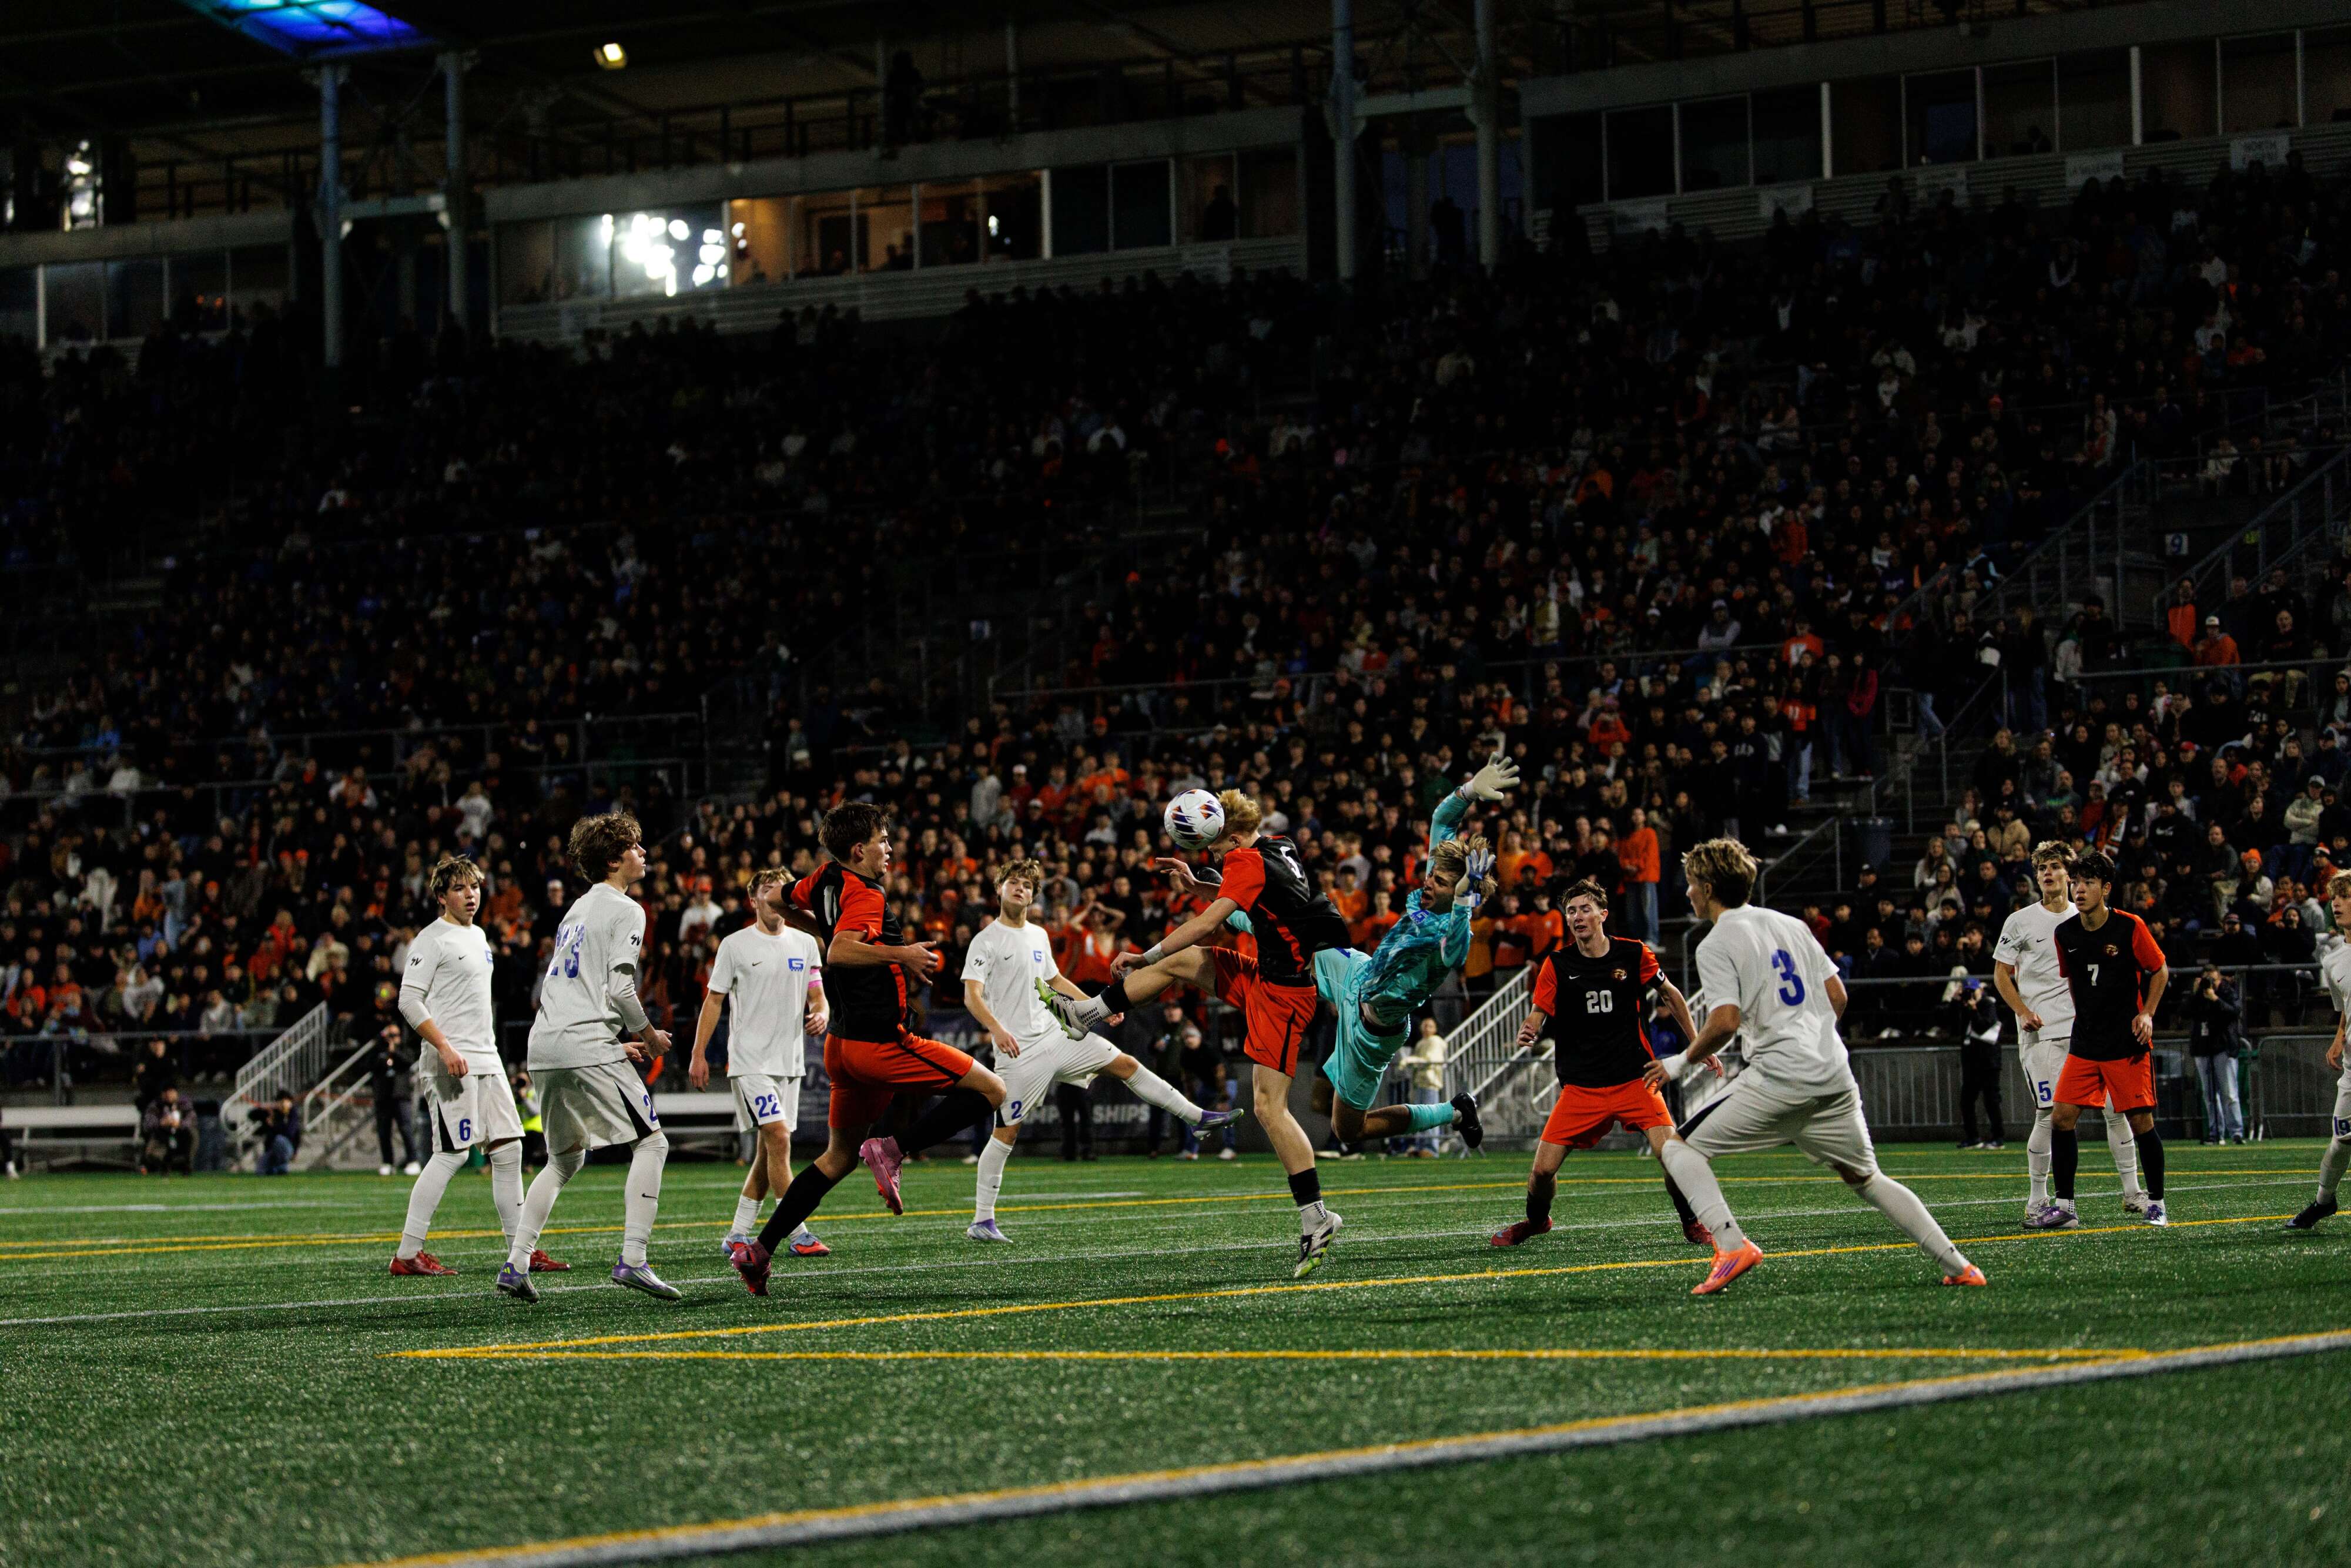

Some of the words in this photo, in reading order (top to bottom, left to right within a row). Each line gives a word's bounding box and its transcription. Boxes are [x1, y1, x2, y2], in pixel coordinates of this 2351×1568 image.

[1771, 949, 1805, 1006] 3
[2087, 964, 2099, 987] 7
[1585, 990, 1613, 1014] 20
[2038, 1081, 2052, 1102] 5
[755, 1094, 781, 1118] 22
[1011, 1100, 1022, 1120] 2
[458, 1118, 471, 1141] 6
